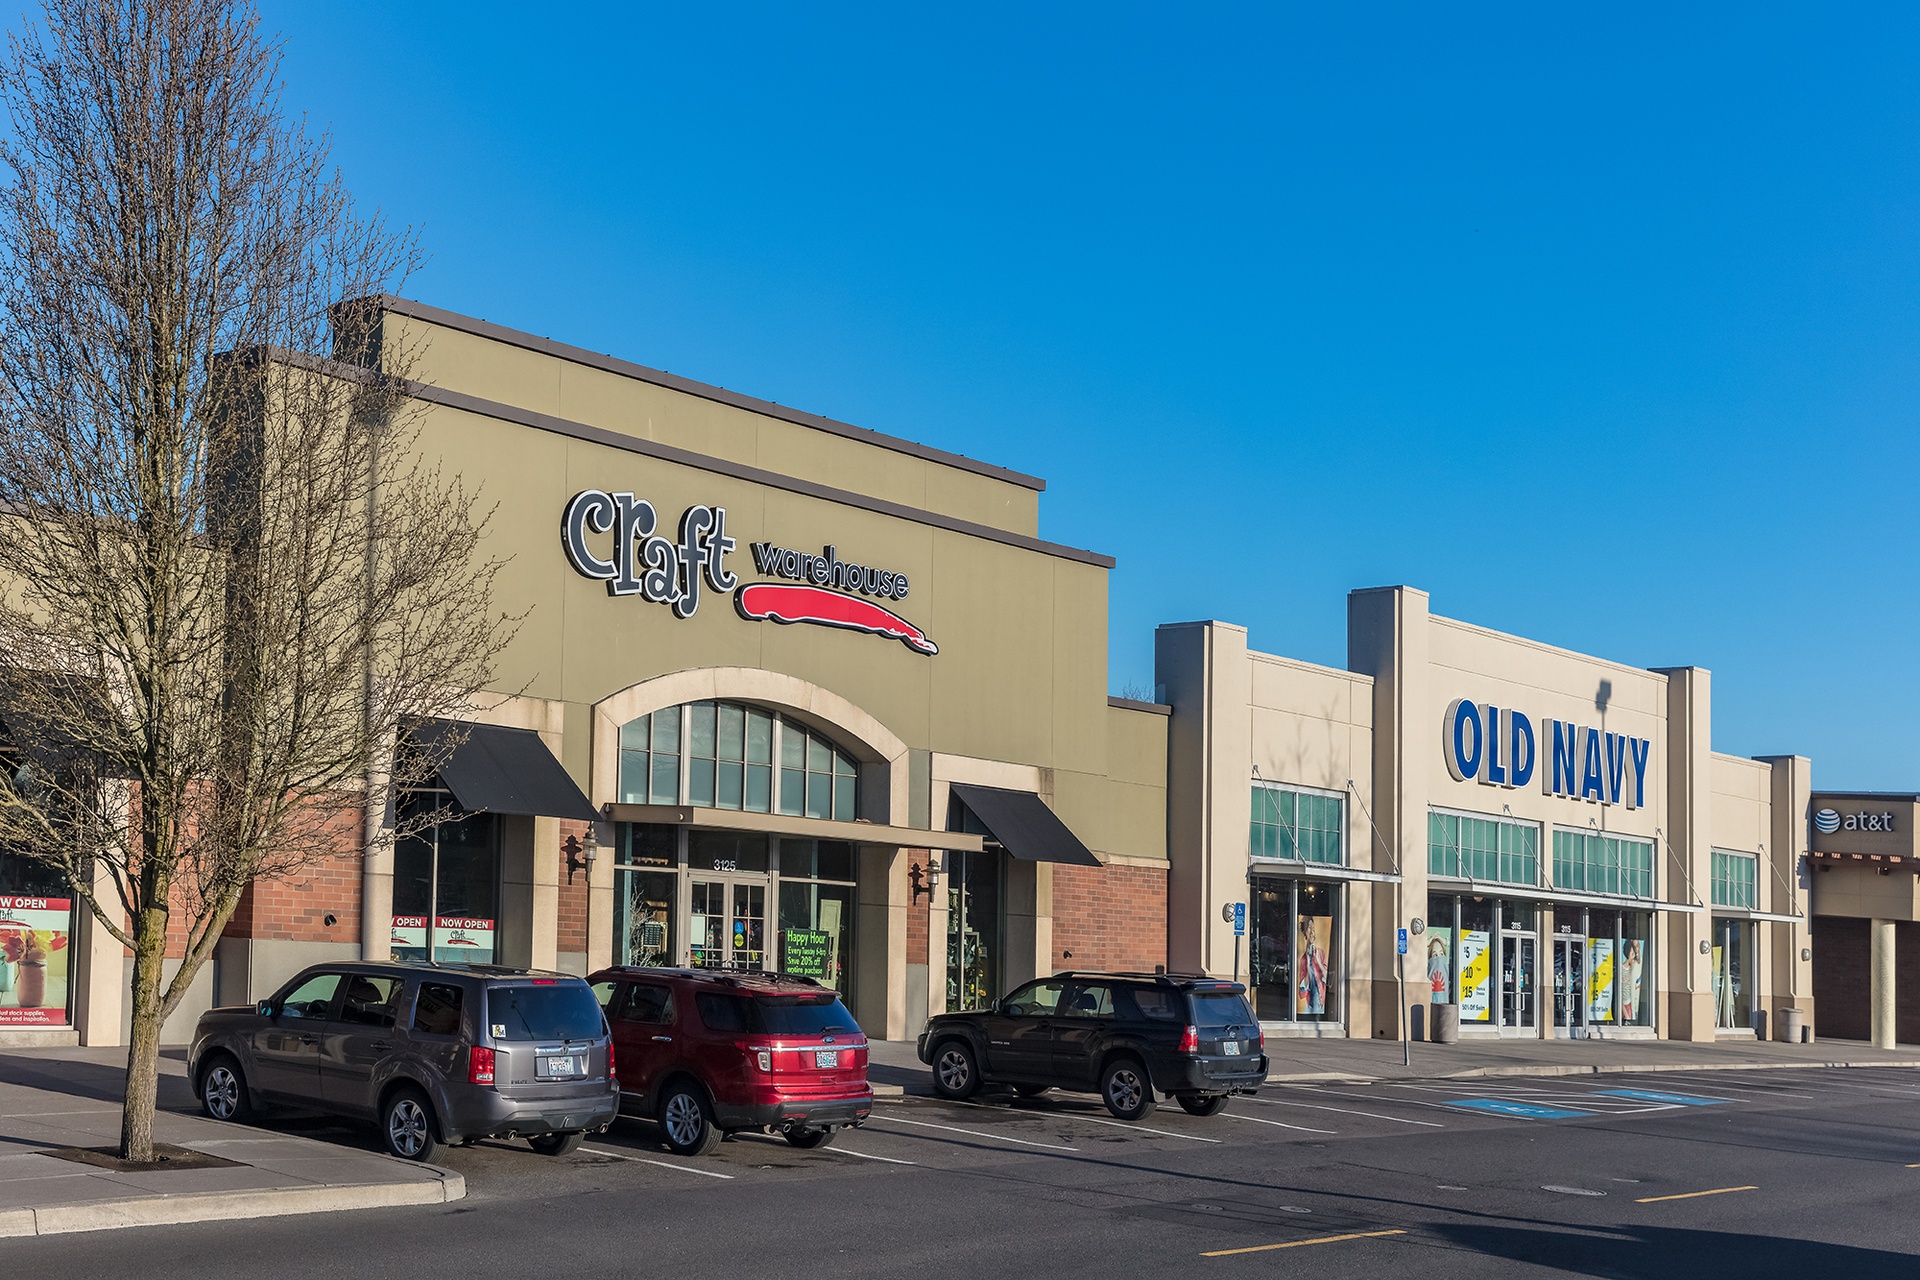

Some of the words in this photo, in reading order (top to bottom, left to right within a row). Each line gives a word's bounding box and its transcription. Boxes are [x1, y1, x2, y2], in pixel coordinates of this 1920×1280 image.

[750, 542, 909, 600] warehouse
[1444, 698, 1535, 788] OLD
[1544, 718, 1651, 809] NAVY
[713, 859, 736, 872] 3125
[15, 898, 47, 909] OPEN
[397, 918, 422, 927] OPEN
[441, 919, 463, 928] NOW
[464, 920, 489, 929] OPEN
[787, 930, 809, 946] Happy
[810, 931, 826, 944] Hour
[787, 946, 801, 957] Every
[787, 956, 800, 965] Save
[801, 956, 813, 966] 20%
